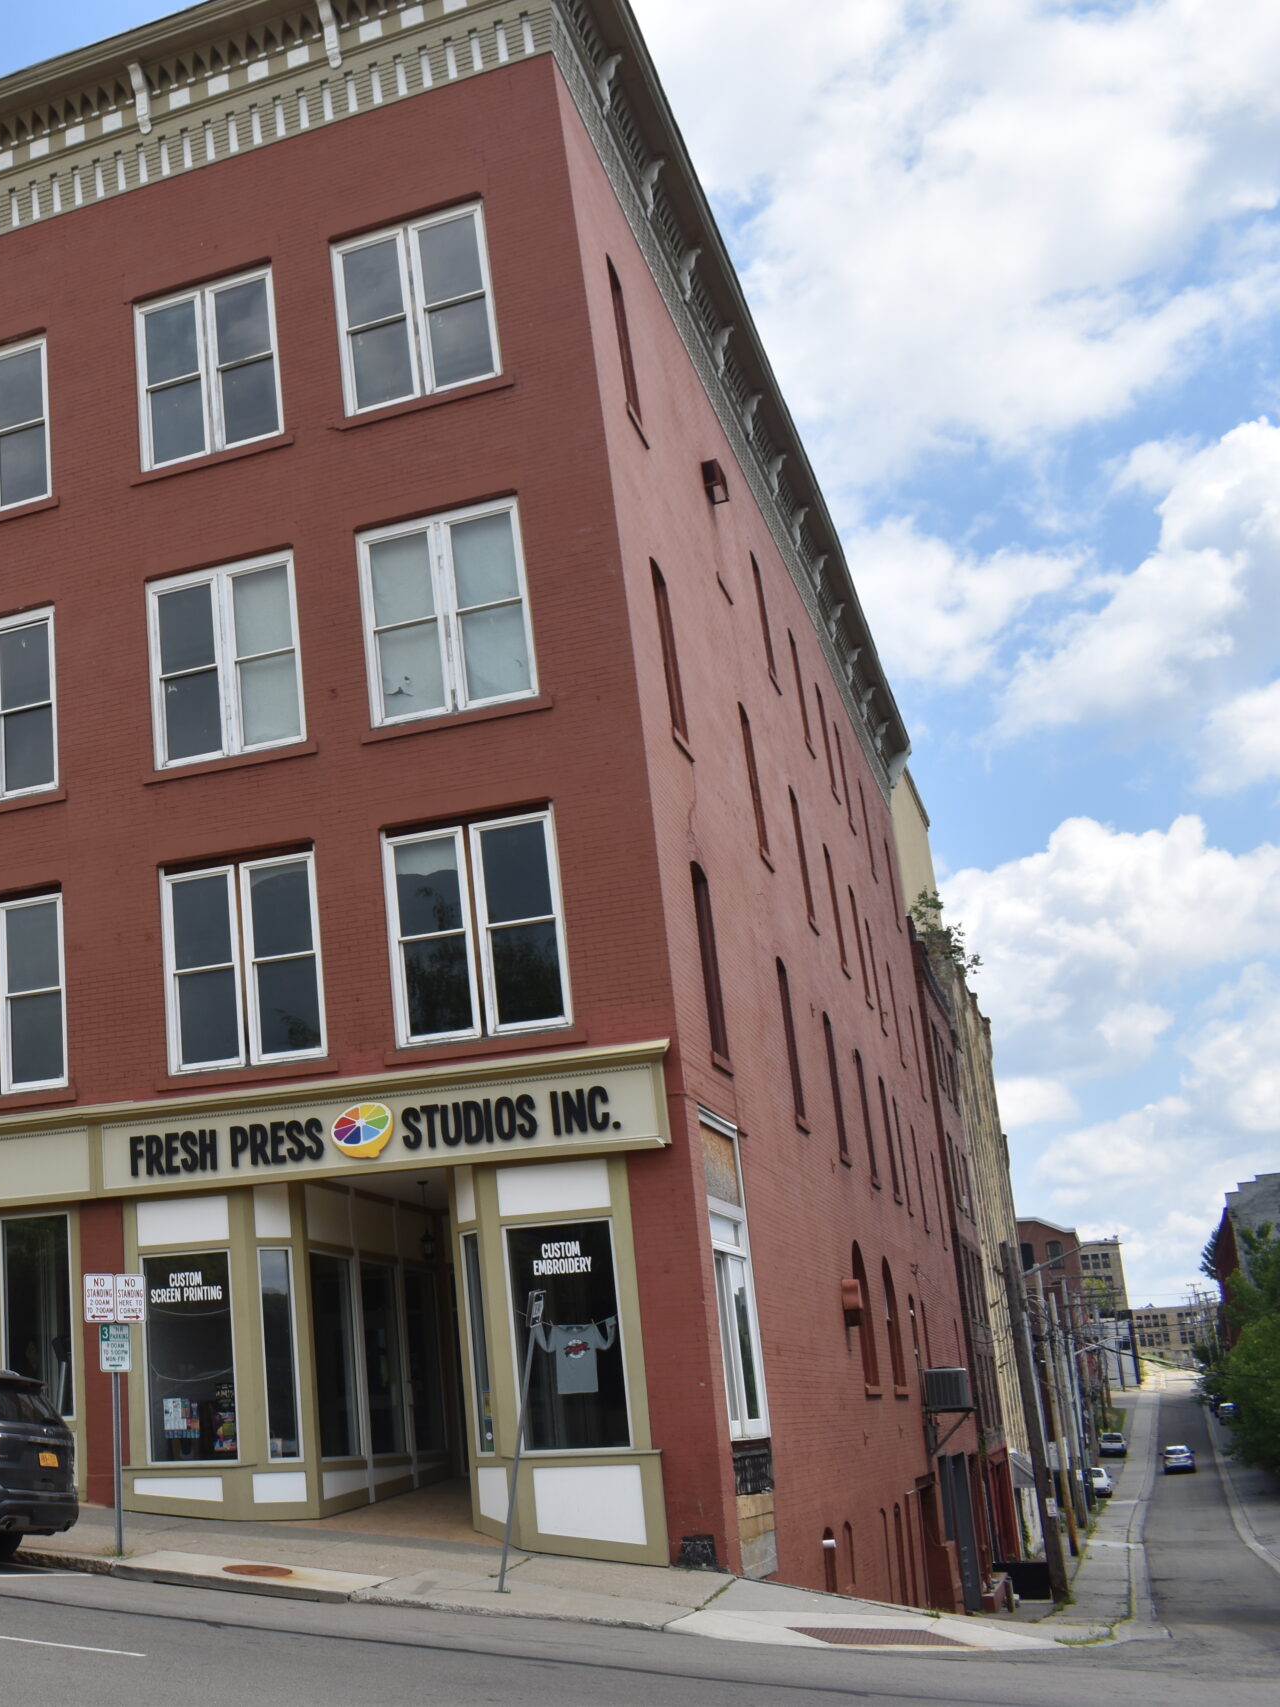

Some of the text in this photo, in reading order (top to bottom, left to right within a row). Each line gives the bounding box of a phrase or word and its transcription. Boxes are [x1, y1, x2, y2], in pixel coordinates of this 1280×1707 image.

[129, 1085, 621, 1177] FRESH PRESS STUDIOS INC.
[541, 1240, 581, 1259] CUSTOM
[533, 1256, 592, 1276] EMBROIDERY
[93, 1278, 105, 1287] NO
[124, 1279, 136, 1288] NO
[169, 1271, 202, 1287] CUSTOM
[87, 1289, 112, 1298] STANDING
[118, 1289, 143, 1298] STANDING
[151, 1285, 222, 1303] SCREEN PRINTING
[102, 1327, 109, 1339] 3
